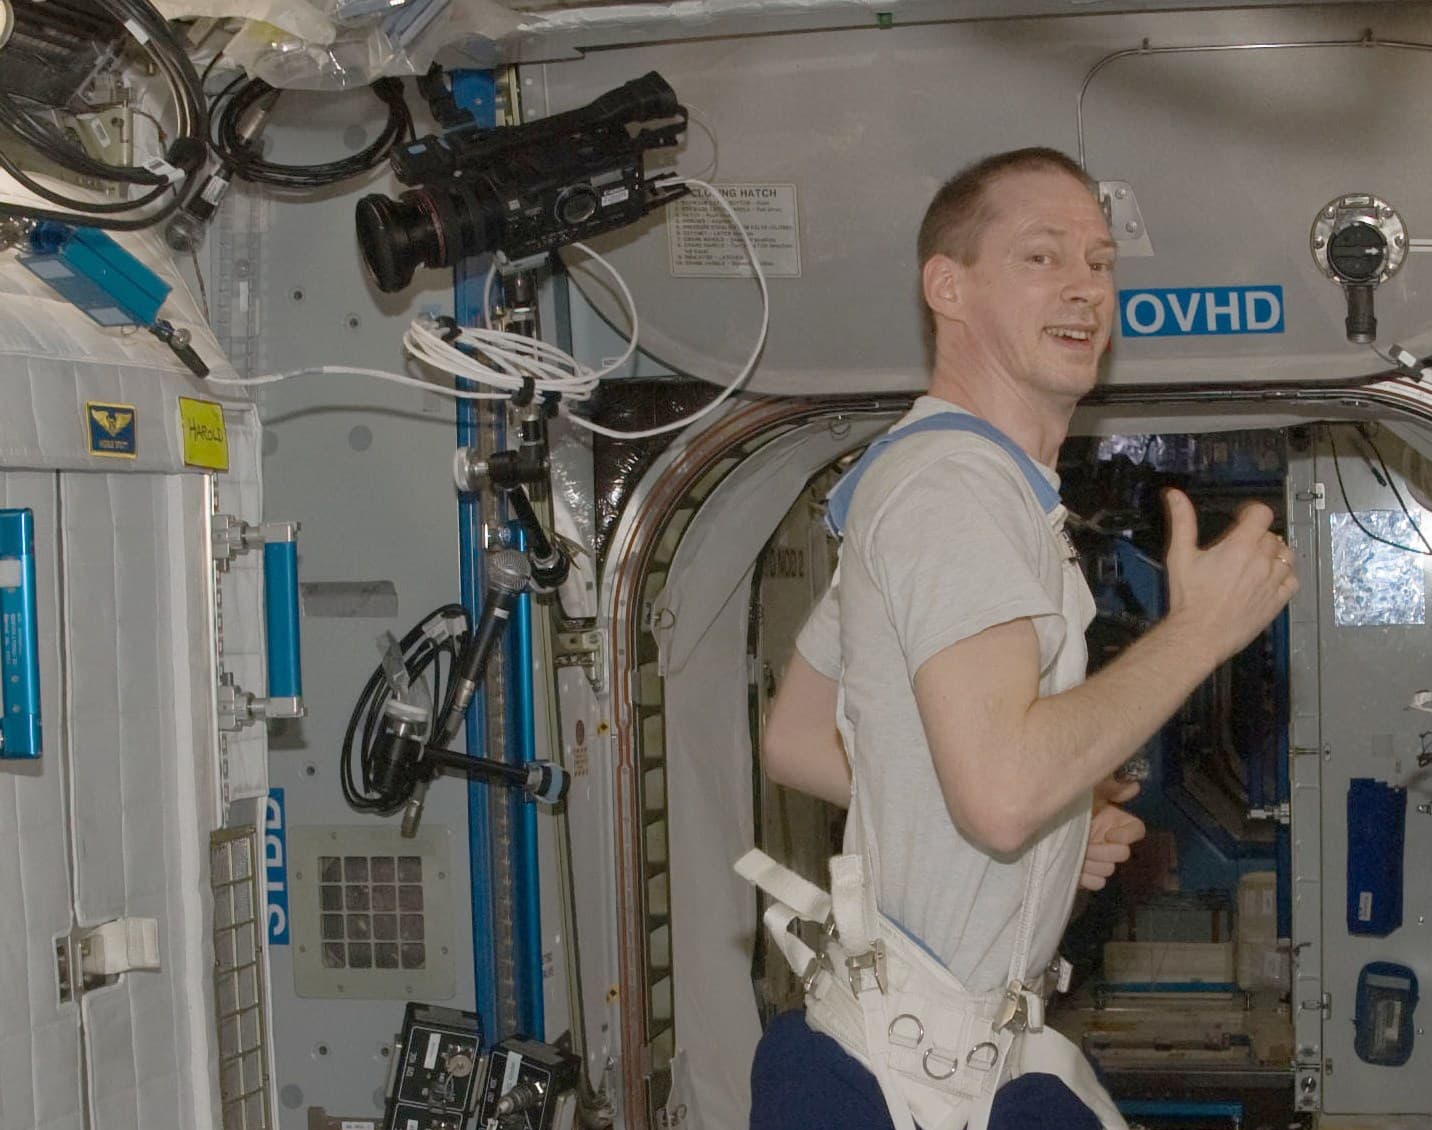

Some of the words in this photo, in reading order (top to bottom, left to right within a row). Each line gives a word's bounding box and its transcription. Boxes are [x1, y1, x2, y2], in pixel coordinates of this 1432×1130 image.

[740, 188, 777, 198] HATCH
[1126, 291, 1281, 334] OVHD
[188, 419, 223, 442] HAROLD
